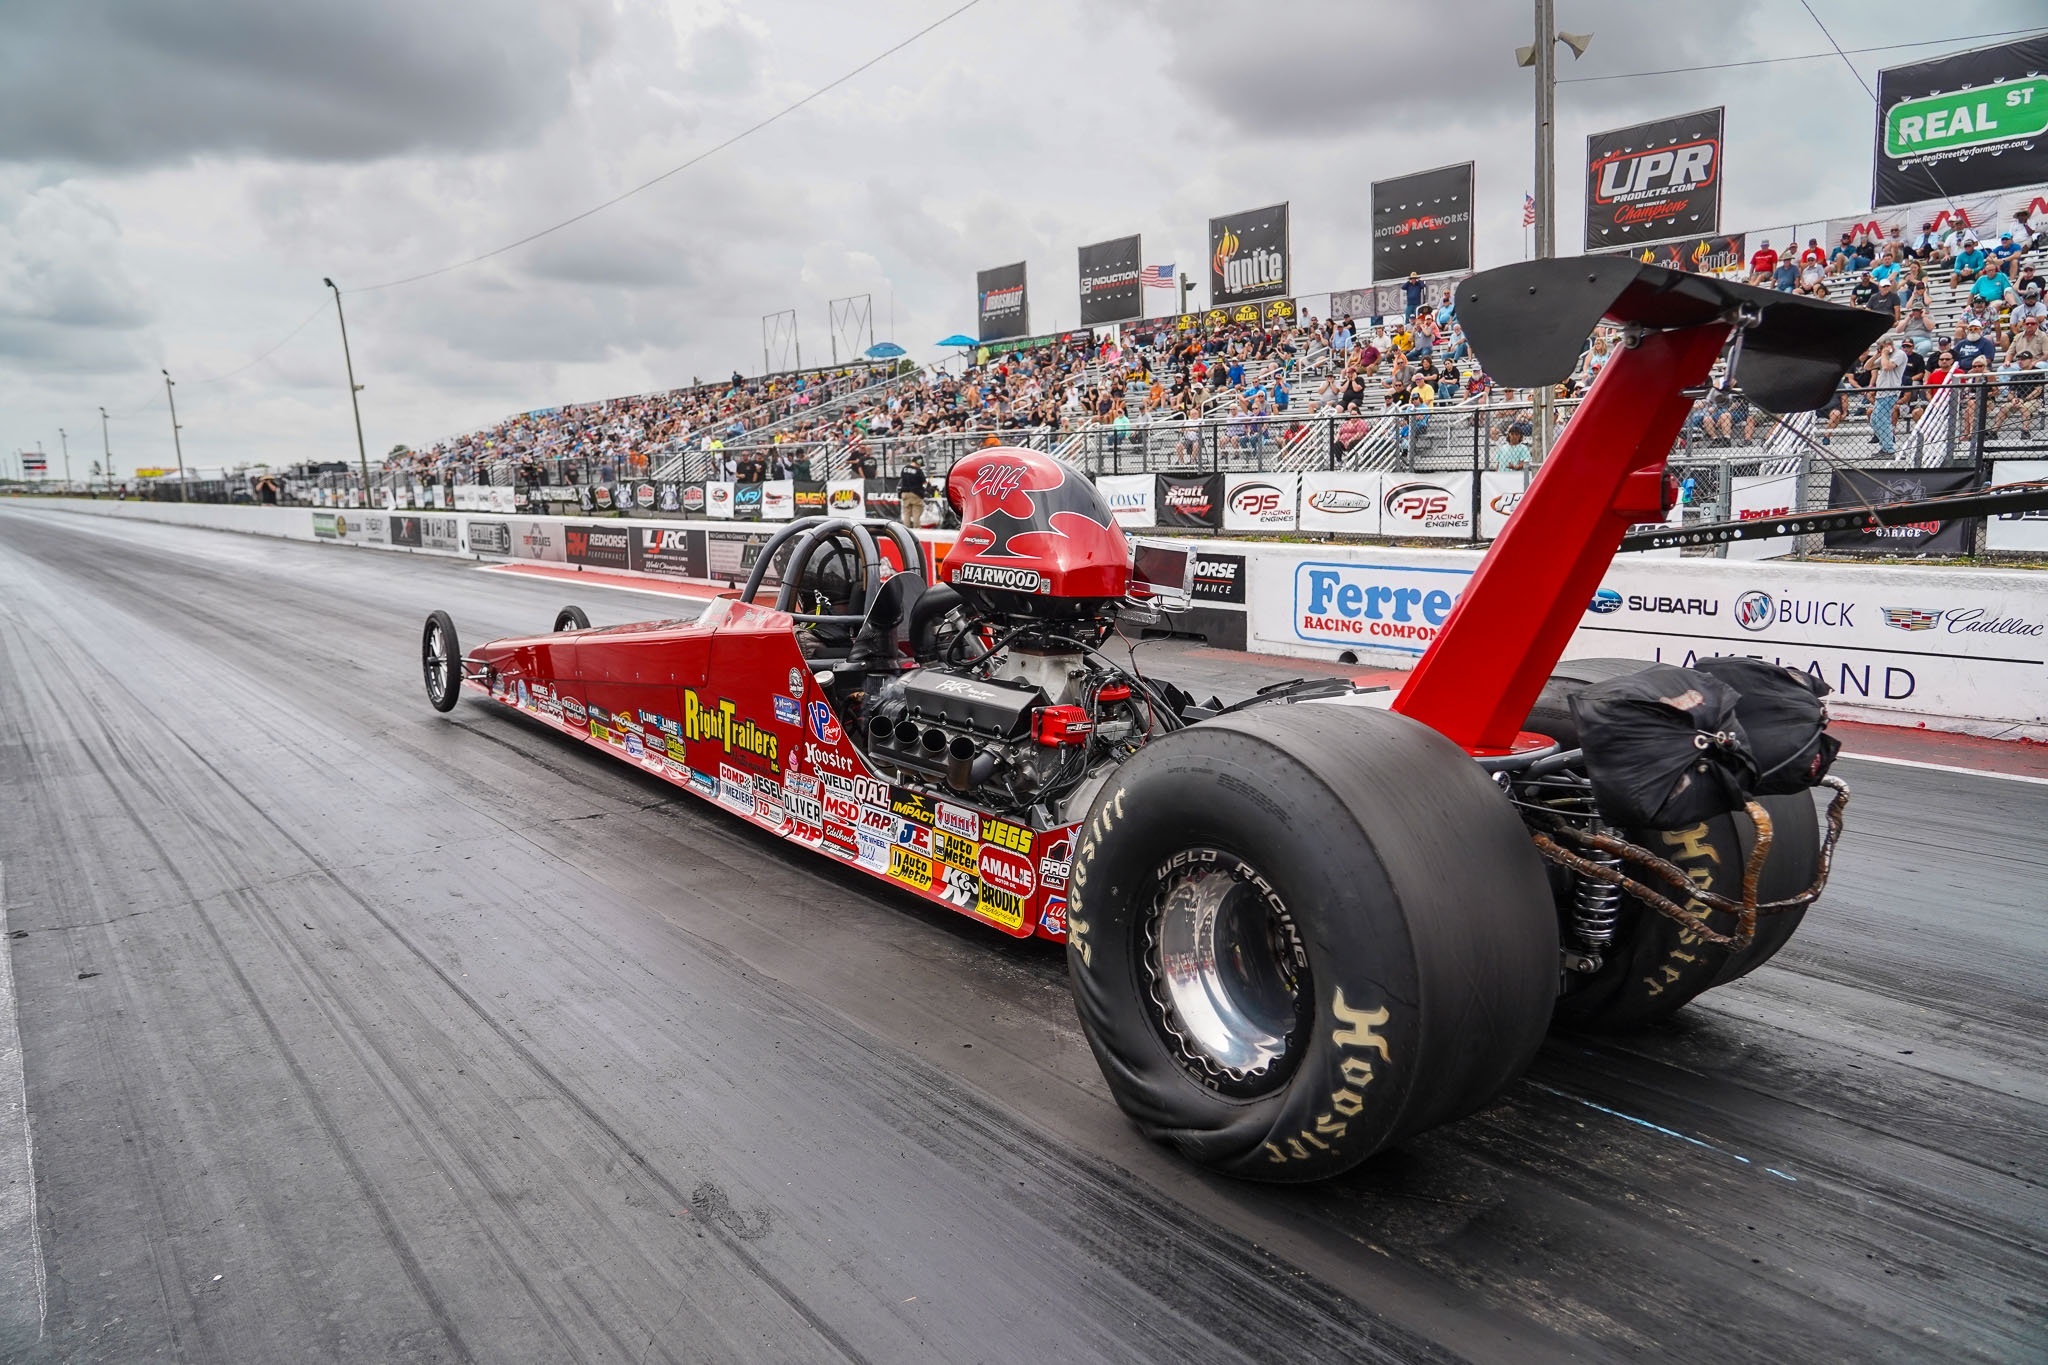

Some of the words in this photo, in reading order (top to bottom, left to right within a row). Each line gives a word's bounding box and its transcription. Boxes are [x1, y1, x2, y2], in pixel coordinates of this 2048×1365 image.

[2005, 88, 2035, 106] ST
[1898, 103, 1997, 145] REAL
[1901, 140, 2029, 166] www.RealStreetPerformance.com
[1600, 144, 1714, 197] UPR
[1612, 182, 1696, 203] PRODUCTS.COM
[1614, 199, 1688, 223] Champions
[1375, 223, 1409, 238] MOTION
[1412, 212, 1469, 231] RACEWORKS
[1092, 270, 1139, 285] INDUCTION
[1224, 250, 1283, 294] ignite
[1110, 493, 1147, 506] COAST
[1164, 495, 1209, 507] Tidwell
[1168, 485, 1204, 498] Scott
[1243, 494, 1280, 515] PJS
[1403, 496, 1449, 520] PJS
[1260, 515, 1294, 523] ENGINES
[1425, 520, 1469, 528] ENGINES
[589, 533, 627, 547] REDHORSE
[1876, 528, 1921, 538] GARAGE
[588, 551, 626, 561] PERFORMANCE
[963, 565, 1039, 589] HARWOOD
[1308, 571, 1458, 625] Ferre
[1628, 595, 1718, 616] SUBARU
[1779, 599, 1855, 628] BUICK
[1945, 608, 2044, 636] Cadillac
[1304, 616, 1363, 634] RACING
[1370, 622, 1441, 641] COMPON
[808, 701, 830, 741] VP
[804, 742, 853, 772] Hoosier
[721, 766, 744, 785] COMP
[753, 774, 782, 800] JESEL
[788, 770, 817, 785] HICKORY
[823, 772, 853, 792] WELD
[726, 785, 754, 807] MEZIERE
[856, 776, 888, 808] QA1
[784, 793, 820, 822] OLIVER
[825, 797, 859, 822] MSD
[893, 801, 935, 824] IMPACT
[937, 803, 977, 835] SUMMIT
[778, 816, 823, 842] ARP
[862, 809, 891, 830] XRP
[826, 825, 855, 845] Edelbrock
[859, 833, 869, 843] THE
[869, 836, 886, 848] WHEEL
[900, 824, 929, 849] JE
[946, 836, 972, 855] Auto
[982, 819, 1033, 854] JEGS
[908, 843, 931, 857] PISTONS
[944, 847, 977, 870] Meter
[900, 864, 931, 885] Meter
[903, 854, 928, 872] Auto
[981, 855, 1032, 888] AMALIE
[1041, 860, 1071, 877] PRO
[995, 877, 1009, 886] MOTOR
[1009, 881, 1017, 889] OIL
[1068, 787, 1128, 968] Hoosier
[981, 881, 1021, 918] BRODIX
[1156, 850, 1217, 880] WELD
[1235, 862, 1309, 968] RACING
[1264, 984, 1392, 1165] Hoosier
